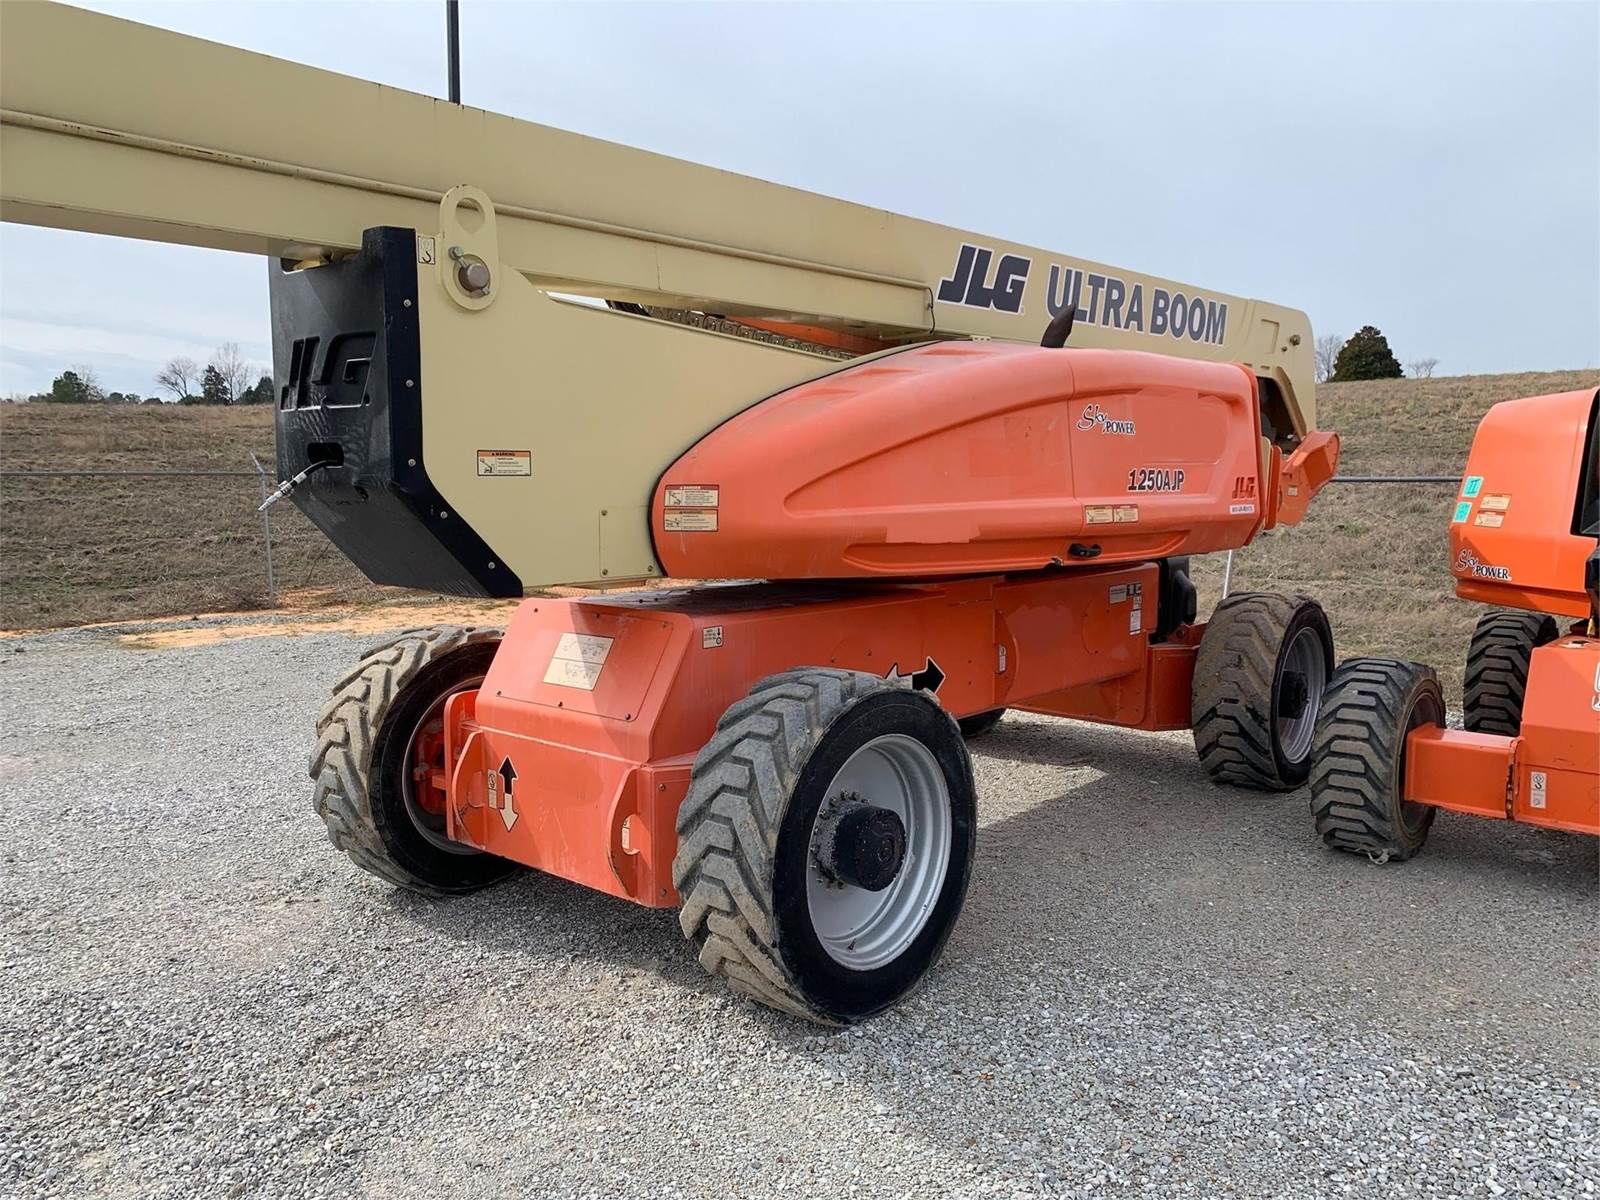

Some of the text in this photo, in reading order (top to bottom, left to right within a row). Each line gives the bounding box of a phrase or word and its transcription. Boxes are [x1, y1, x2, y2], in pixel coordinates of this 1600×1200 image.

[937, 244, 1228, 345] JLG ULTRA BOOM
[280, 331, 377, 412] JLG
[1104, 420, 1135, 435] POWER
[1127, 468, 1185, 492] 1250AJP
[1231, 476, 1256, 499] JLG
[1473, 564, 1510, 580] POWER
